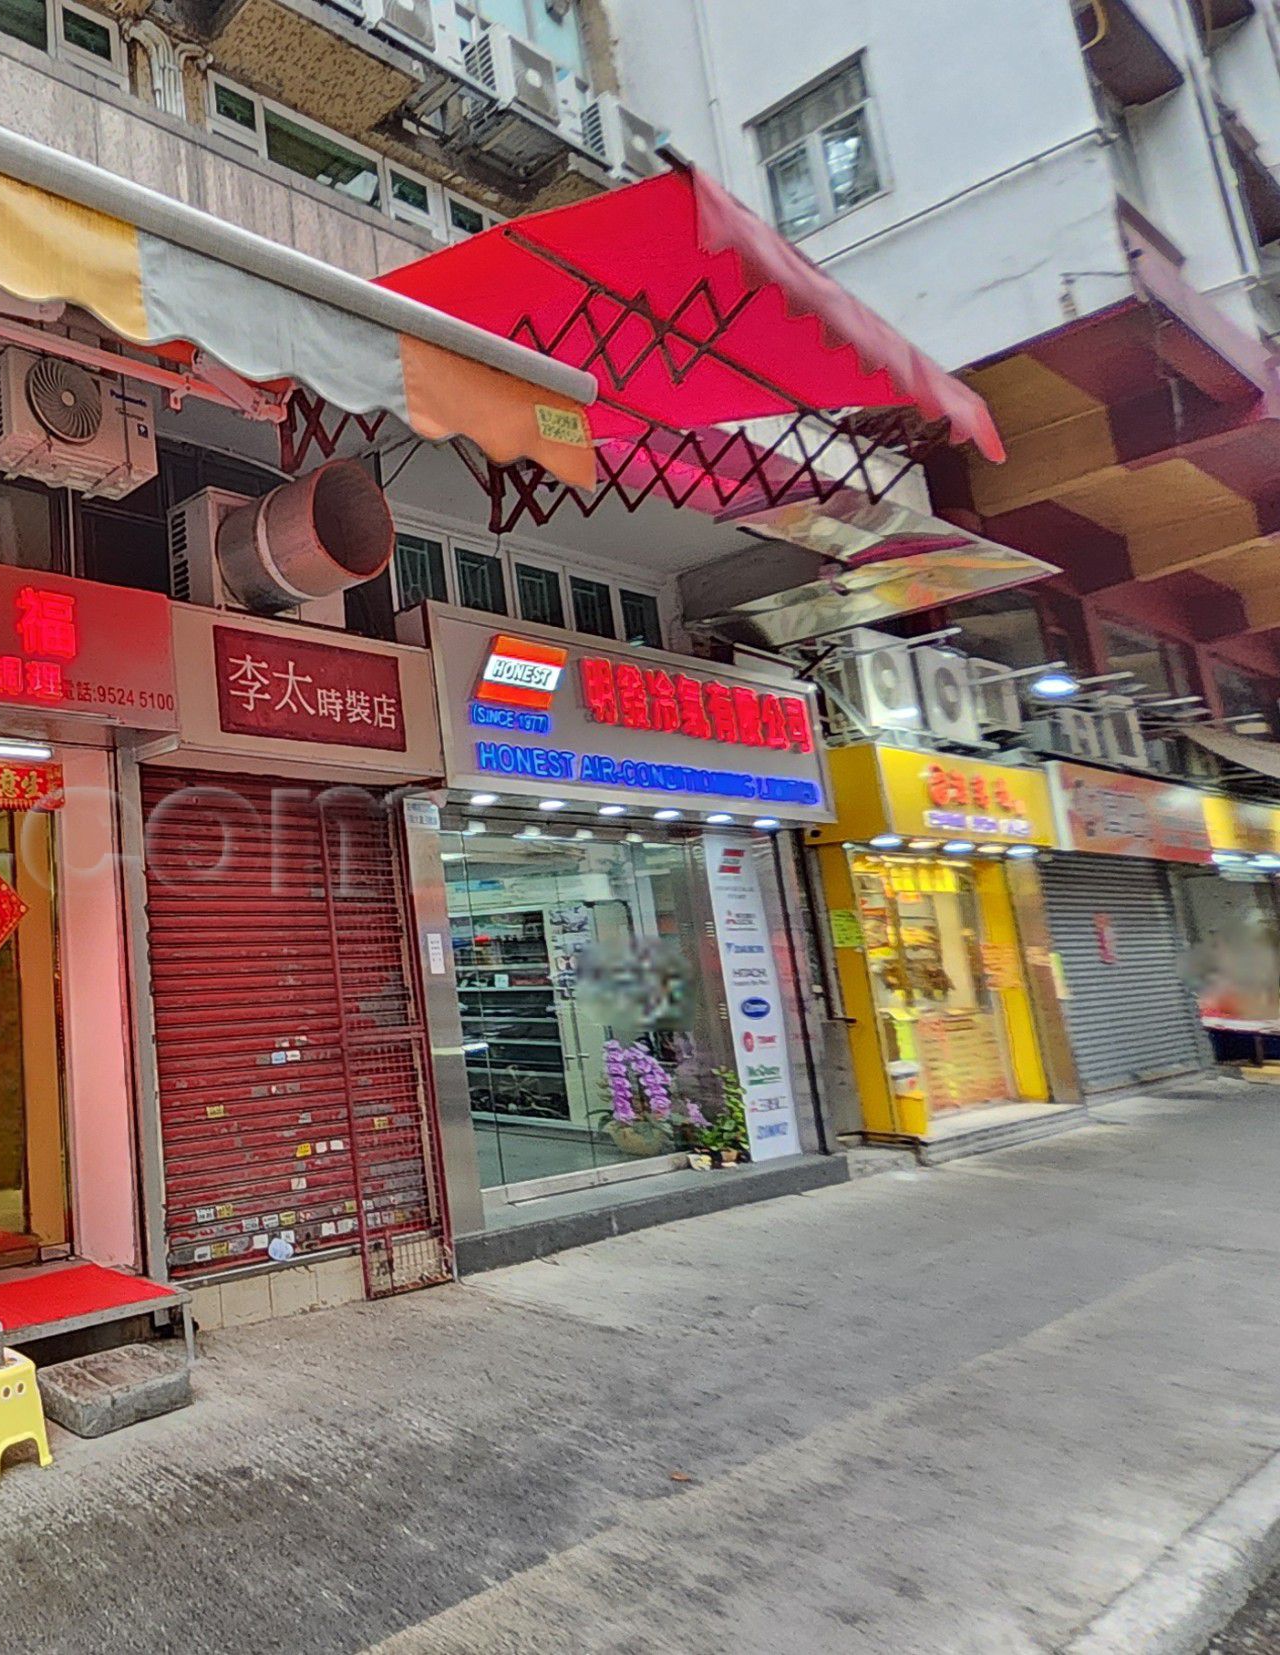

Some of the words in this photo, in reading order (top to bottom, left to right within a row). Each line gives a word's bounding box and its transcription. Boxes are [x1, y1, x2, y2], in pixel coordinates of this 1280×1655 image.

[228, 654, 397, 730] 李太時裝店
[492, 659, 552, 687] HONEST
[140, 691, 175, 711] 5100
[477, 741, 575, 780] HONEST
[579, 754, 756, 799] AIR-CONDITIOG
